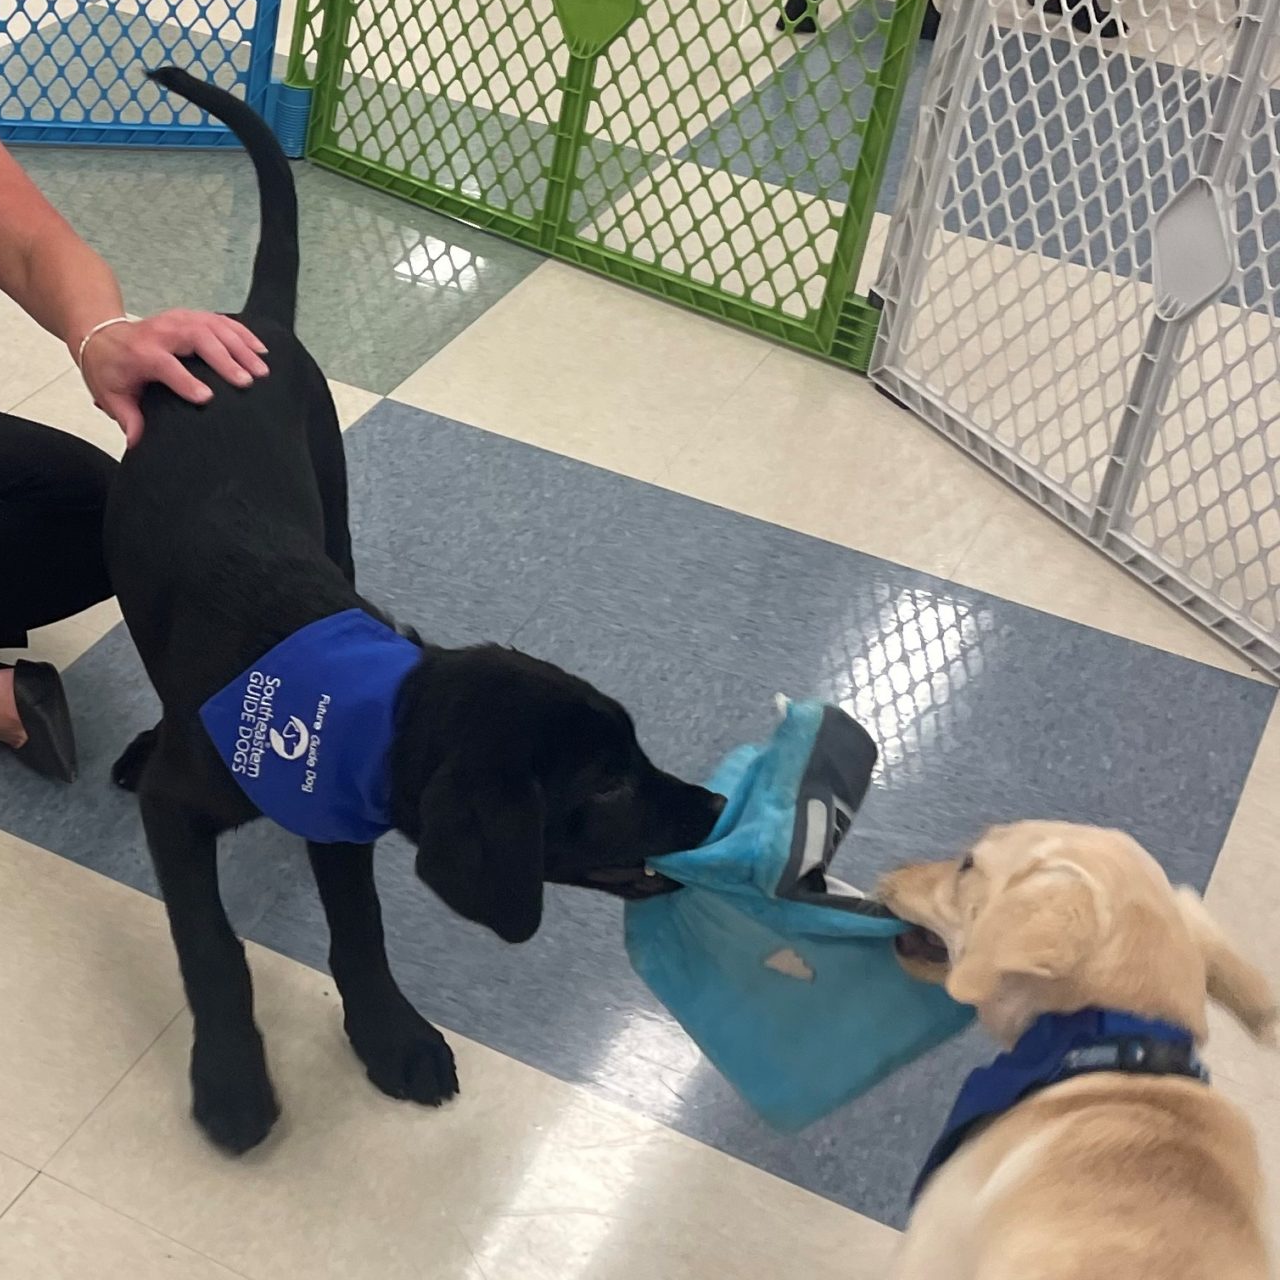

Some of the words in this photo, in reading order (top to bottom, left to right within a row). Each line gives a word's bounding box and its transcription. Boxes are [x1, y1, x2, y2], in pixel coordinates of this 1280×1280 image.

[240, 671, 265, 724] GUIDE
[313, 693, 331, 730] Future
[246, 675, 281, 778] Southeastern
[231, 725, 253, 774] DOGS
[305, 734, 321, 767] Guide
[301, 770, 317, 793] Dog
